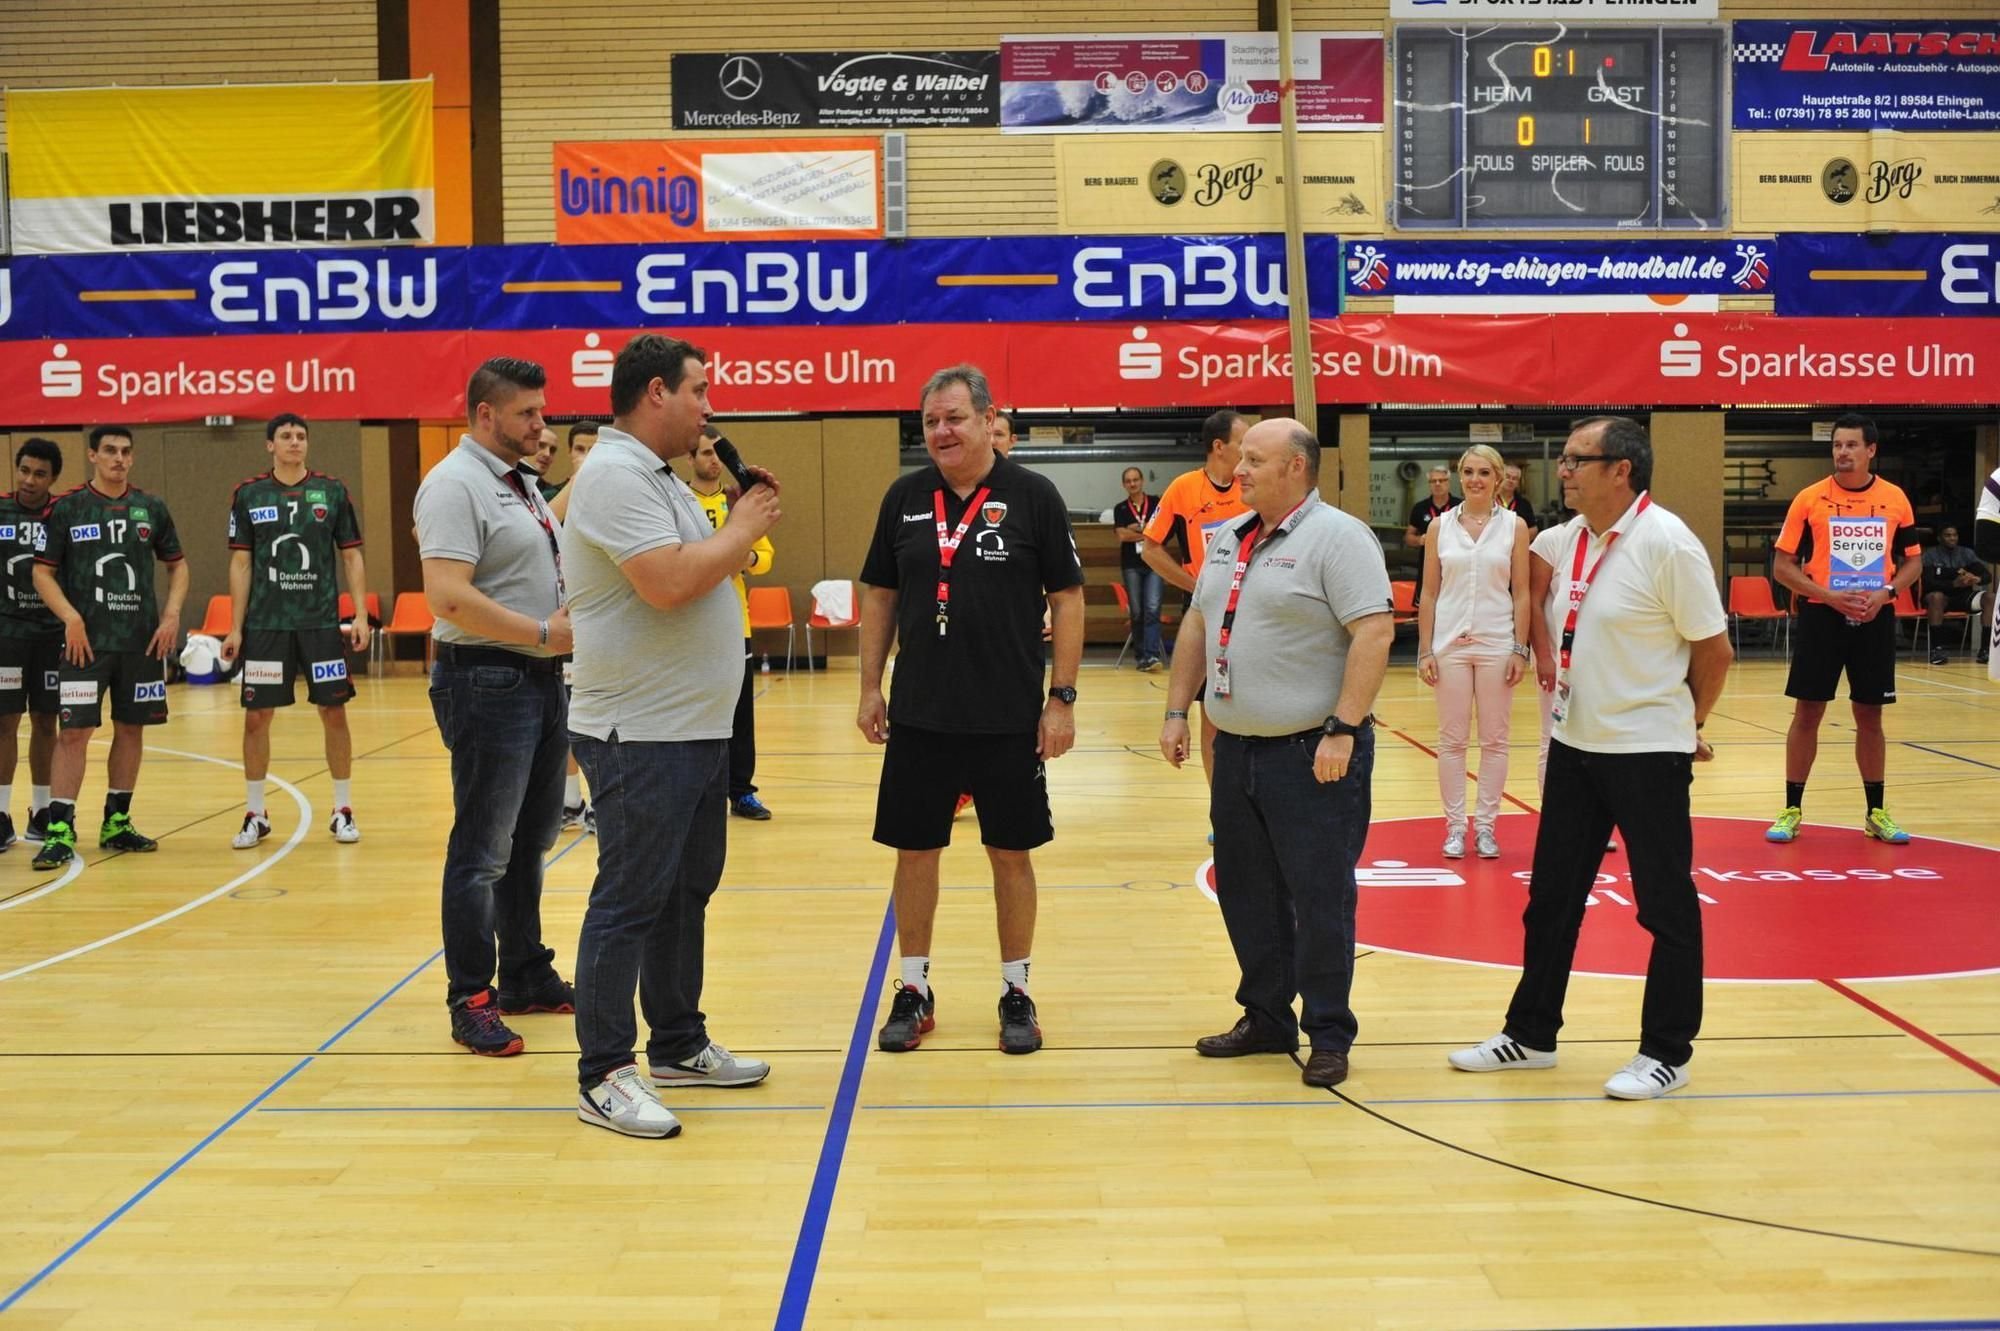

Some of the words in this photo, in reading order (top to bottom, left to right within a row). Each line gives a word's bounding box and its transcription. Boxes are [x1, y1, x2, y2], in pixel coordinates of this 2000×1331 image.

[1406, 64, 1413, 72] 5
[1670, 64, 1676, 72] 5
[1829, 62, 1875, 72] Autoteile
[1883, 61, 1948, 72] Autozubehör
[817, 74, 887, 96] Vögtle
[892, 75, 909, 91] &
[915, 74, 988, 91] Waibel
[1406, 77, 1413, 85] 6
[1670, 77, 1676, 85] 6
[1474, 86, 1532, 102] HEIM
[1588, 86, 1645, 102] GAST
[1223, 90, 1279, 111] Mantz
[1802, 95, 1871, 106] Hauptstraße
[1874, 95, 1891, 105] 8/2
[1900, 95, 1933, 105] 89584
[1936, 95, 1983, 107] Ehingen
[1670, 104, 1676, 112] 8
[1748, 108, 1771, 119] Tel.:
[1774, 107, 1815, 120] (07391)
[1818, 109, 1832, 118] 78
[1835, 109, 1849, 118] 95
[1852, 108, 1871, 118] 280
[683, 109, 801, 127] Mercedes-Benz
[1406, 117, 1413, 125] 9
[1670, 117, 1676, 125] 9
[1404, 131, 1413, 139] 10
[1517, 116, 1534, 146] 0
[1667, 131, 1676, 139] 10
[1404, 144, 1413, 152] 11
[1667, 144, 1676, 152] 11
[1404, 157, 1413, 165] 12
[1474, 155, 1515, 171] FOULS
[1532, 155, 1587, 171] SPIELER
[1604, 155, 1645, 171] FOULS
[1667, 157, 1676, 165] 12
[1404, 170, 1413, 178] 13
[1667, 170, 1676, 178] 13
[1759, 175, 1777, 183] BERG
[1779, 175, 1813, 184] BRAUEREI
[1934, 175, 1958, 184] ULRICH
[1084, 177, 1102, 186] BERG
[1104, 177, 1139, 186] BRAUEREI
[1194, 162, 1263, 206] Berg
[1302, 176, 1355, 185] ZIMMERMANN
[1865, 160, 1922, 204] Berg
[1667, 184, 1676, 192] 14
[560, 167, 698, 228] binnig
[1404, 197, 1413, 205] 15
[1667, 197, 1676, 205] 15
[109, 196, 422, 246] LIEBHERR
[742, 216, 787, 227] EHINGEN
[1395, 255, 1727, 287] www.tsg-ehingen-handball.de
[636, 251, 868, 315] EnBW
[210, 258, 437, 323] EnBW
[1373, 344, 1443, 377] Ulm
[1717, 344, 1897, 385] Sparkasse
[1907, 344, 1975, 377] Ulm
[704, 348, 814, 385] rkasse
[825, 349, 896, 385] Ulm
[98, 361, 276, 404] Sparkasse
[285, 358, 355, 393] Ulm
[250, 508, 276, 521] DKB
[287, 501, 298, 525] 7
[903, 511, 933, 523] hummel
[72, 526, 99, 539] DKB
[107, 519, 127, 543] 17
[1833, 526, 1883, 537] BOSCH
[1833, 539, 1883, 551] Service
[279, 573, 318, 581] Deutsche
[280, 582, 314, 590] Wohnen
[1833, 579, 1849, 587] Car
[107, 602, 139, 611] Wohnen
[314, 662, 346, 680] DKB
